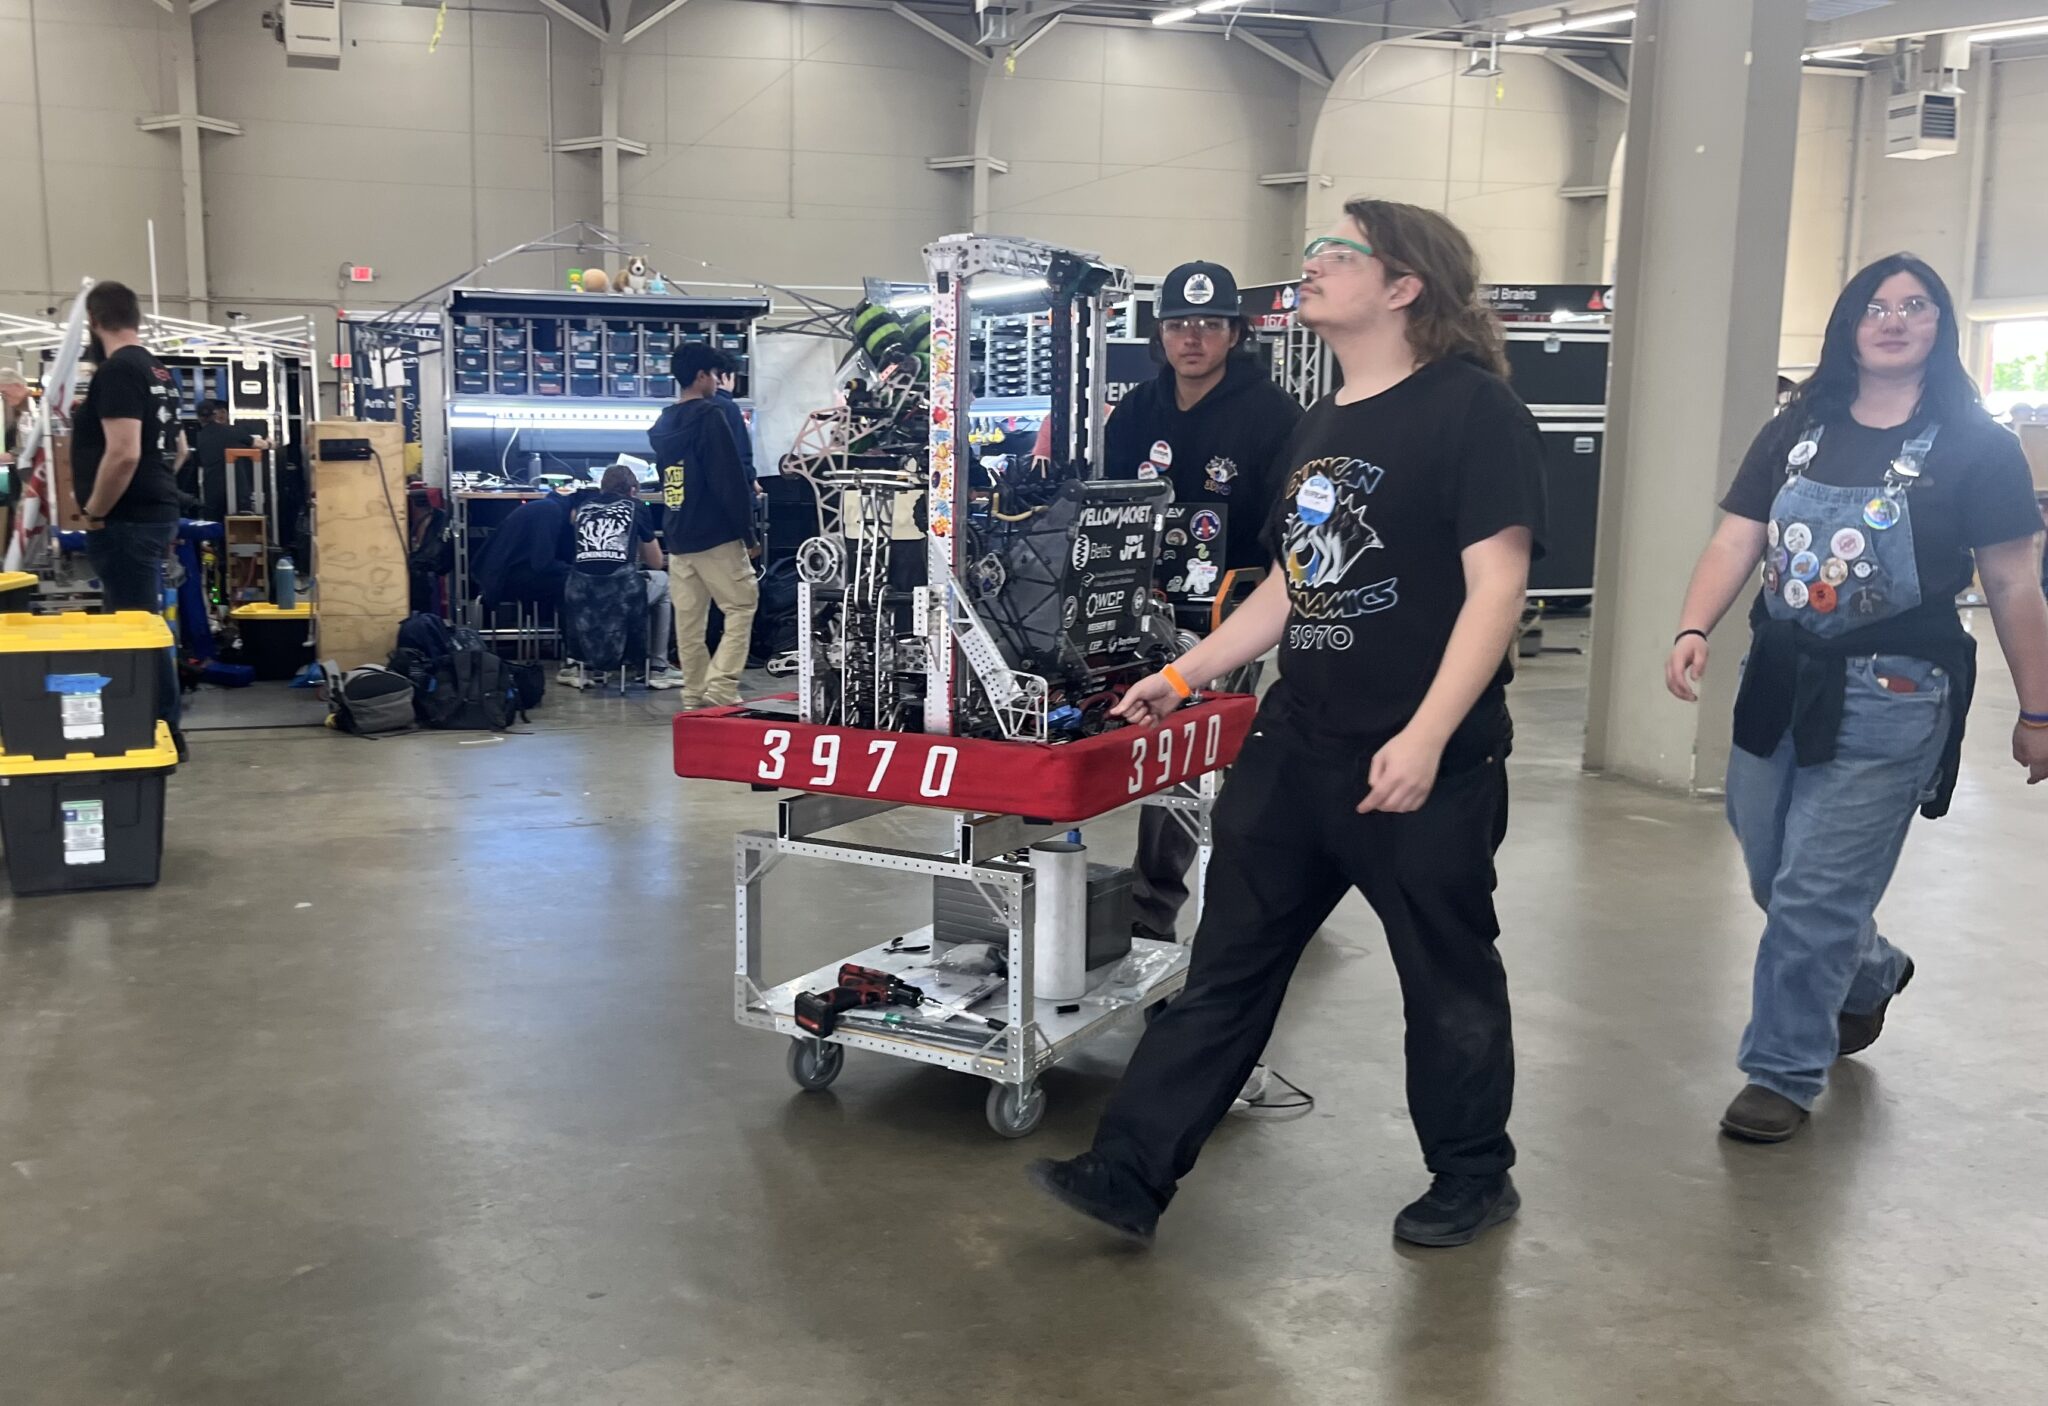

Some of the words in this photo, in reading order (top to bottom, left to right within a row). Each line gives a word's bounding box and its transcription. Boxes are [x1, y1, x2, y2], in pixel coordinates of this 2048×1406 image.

[1501, 287, 1537, 300] Brains
[1079, 505, 1152, 529] YELLOWJACKET
[1164, 508, 1186, 518] EV
[576, 550, 627, 561] PENINSULA
[1120, 534, 1146, 561] JPL
[1097, 591, 1125, 607] WCP
[1290, 577, 1398, 619] NAMICS
[1289, 624, 1354, 650] 3970
[757, 728, 958, 798] 3970
[1127, 714, 1221, 794] 3970
